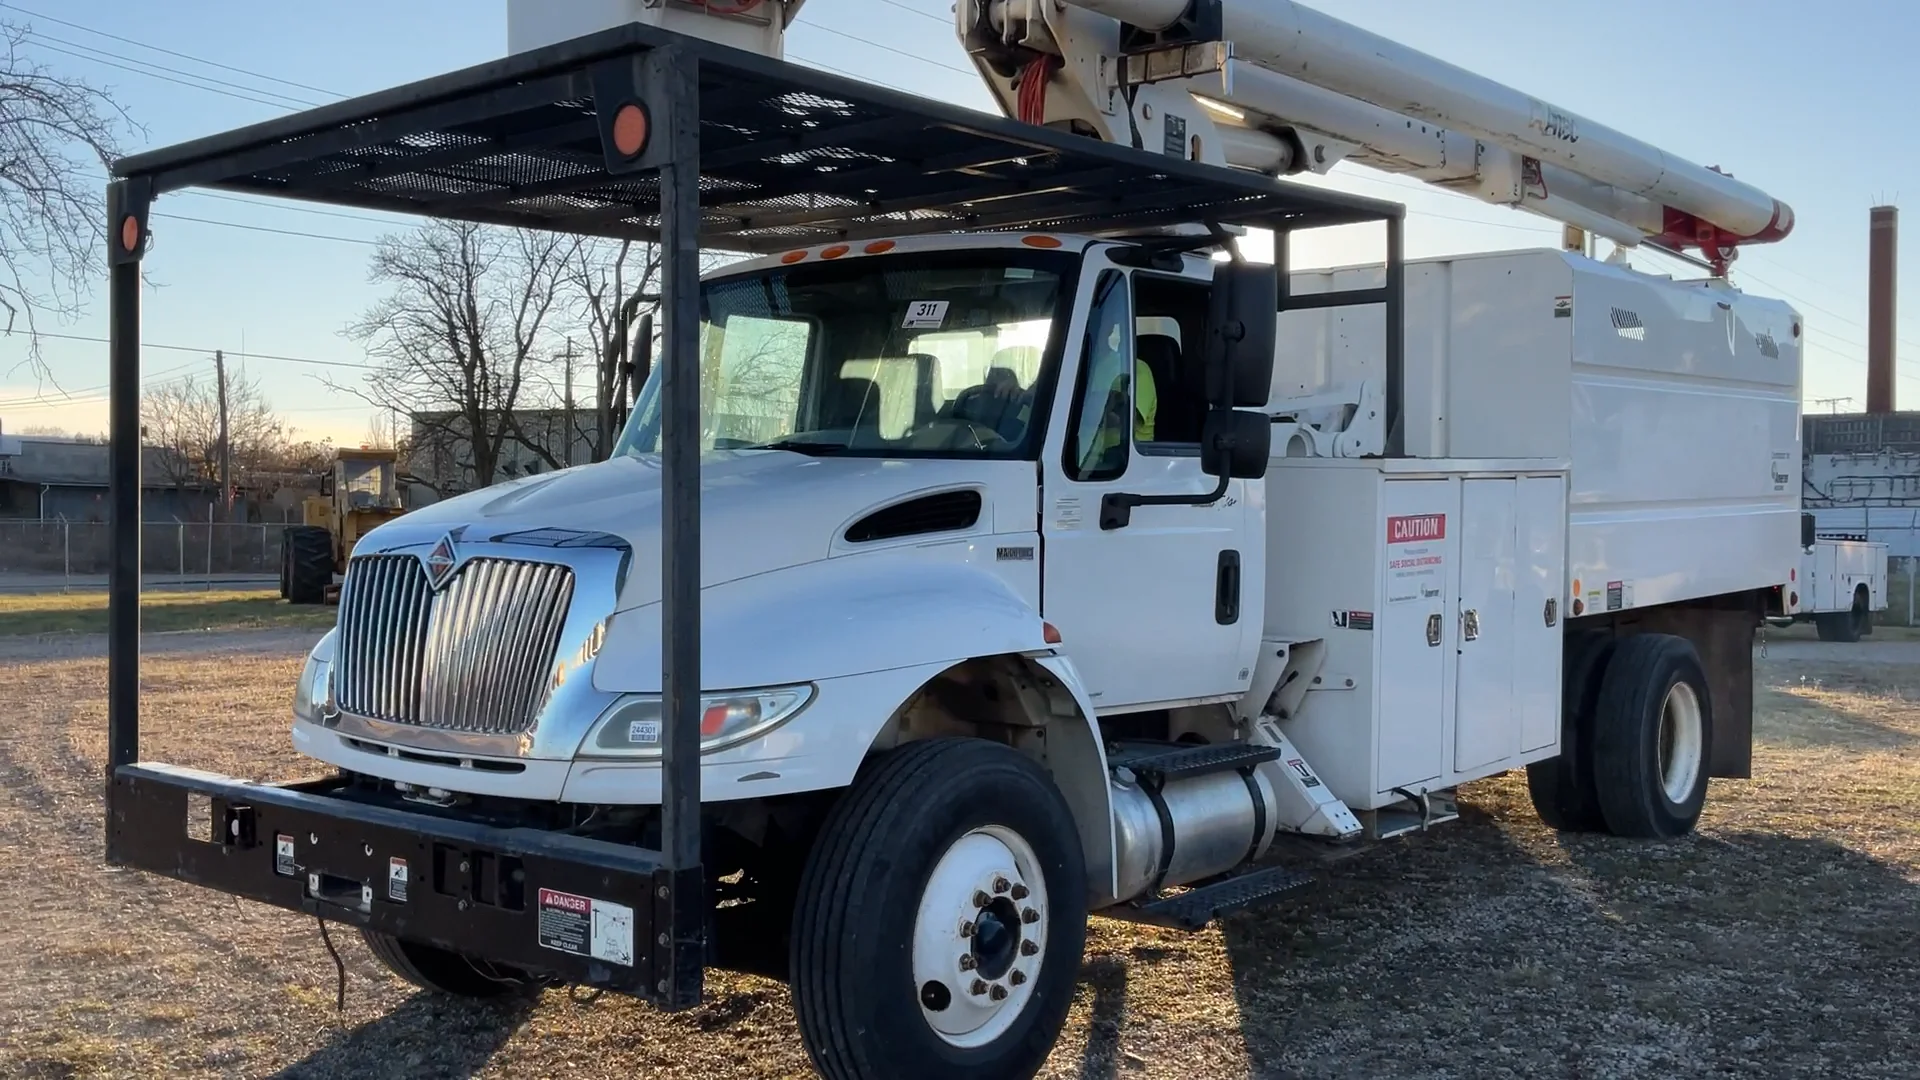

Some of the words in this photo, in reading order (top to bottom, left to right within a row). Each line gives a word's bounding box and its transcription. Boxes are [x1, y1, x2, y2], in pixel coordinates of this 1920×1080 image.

[917, 303, 938, 316] 311
[1394, 518, 1439, 539] CAUTION
[553, 895, 586, 911] DANGER
